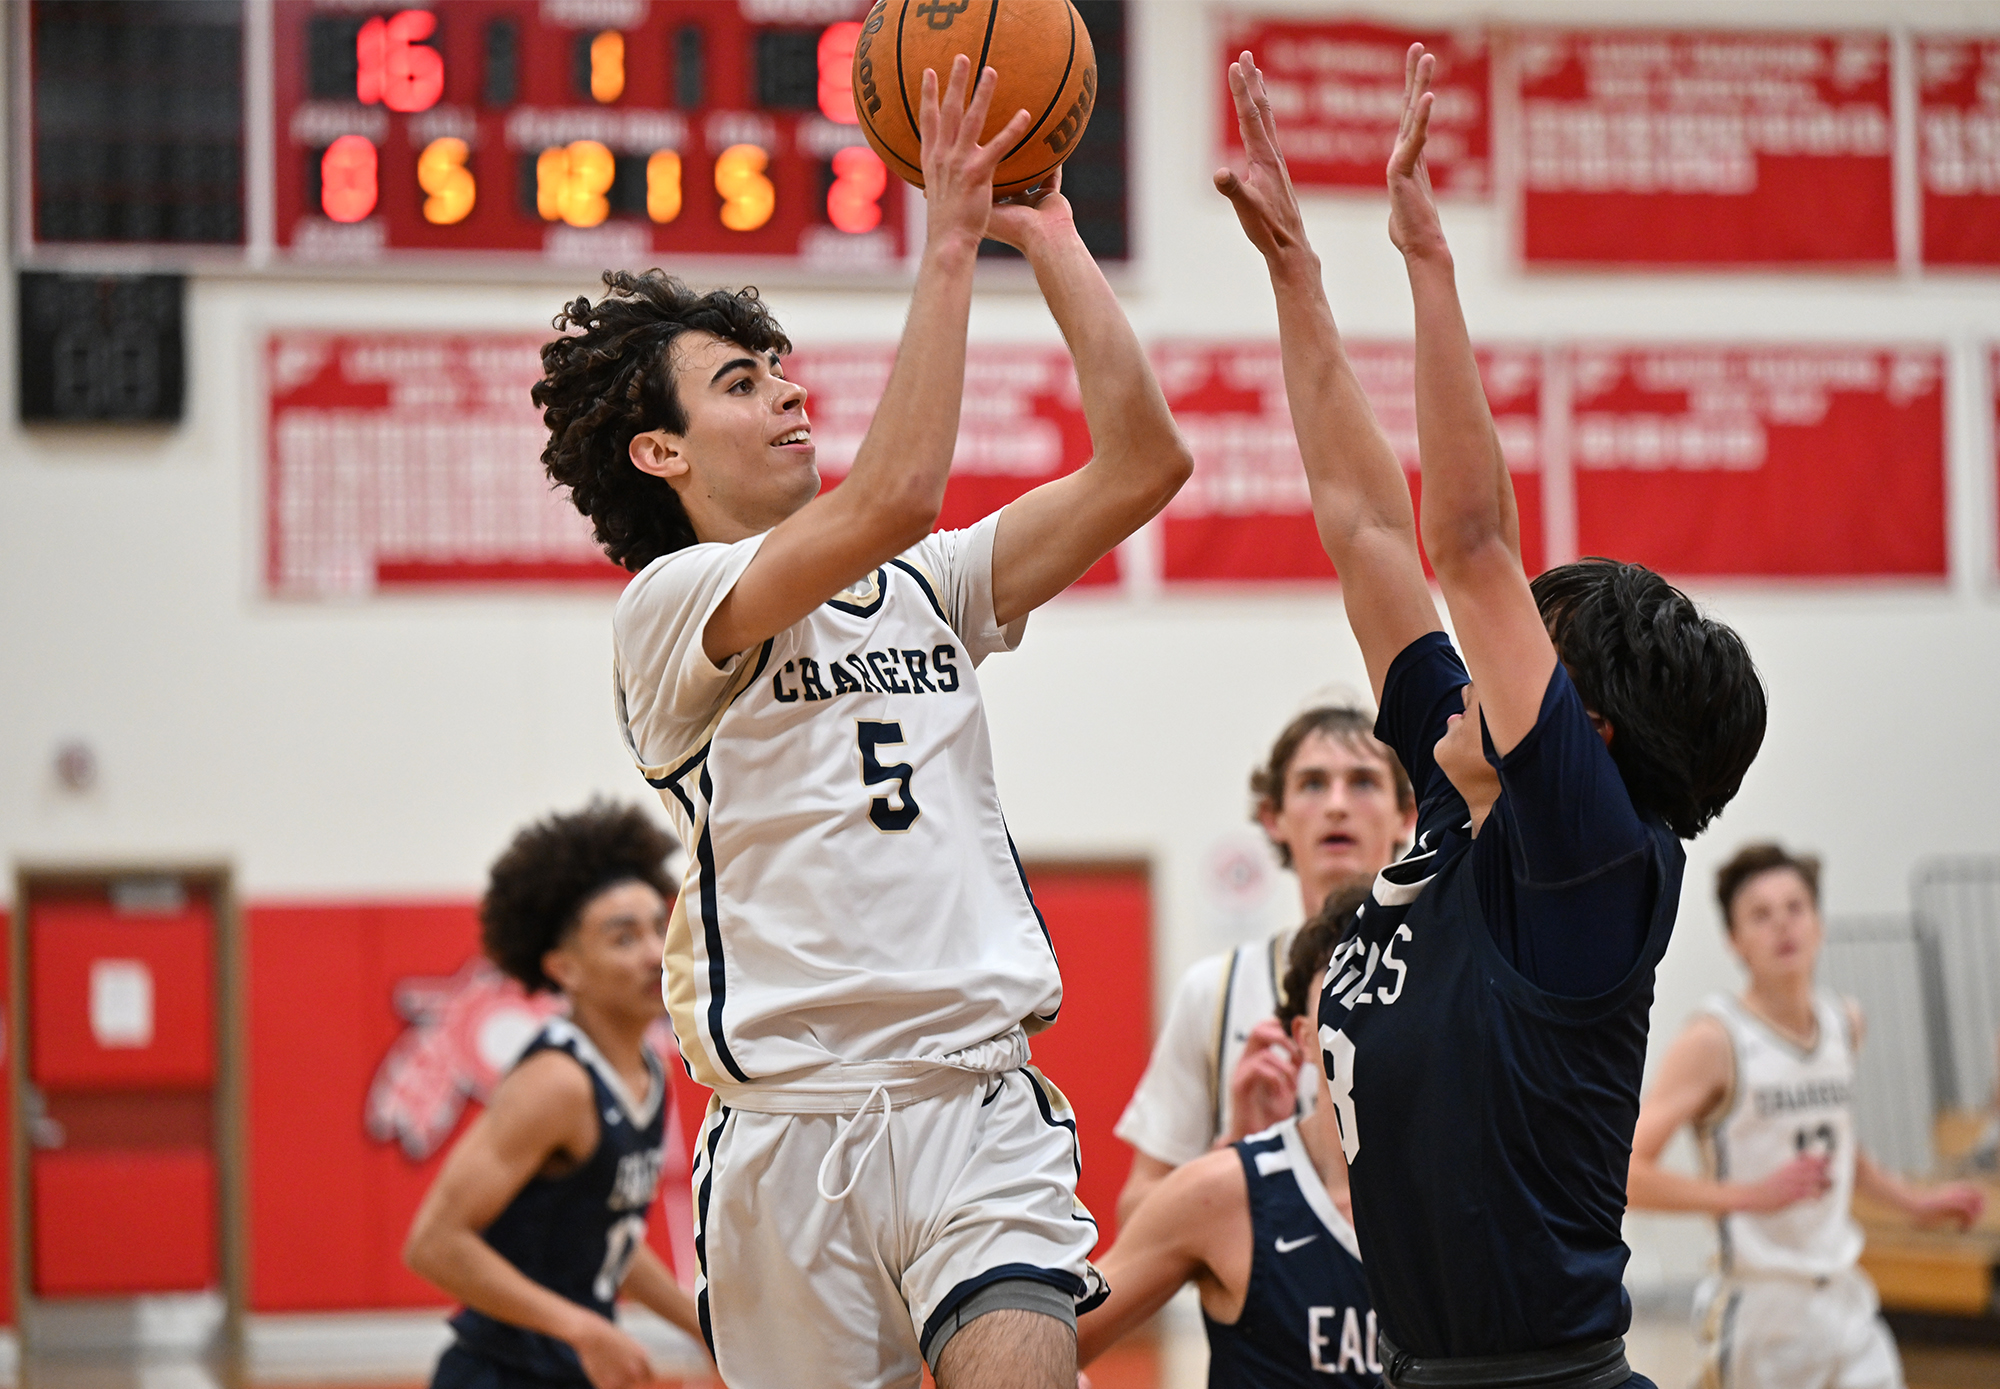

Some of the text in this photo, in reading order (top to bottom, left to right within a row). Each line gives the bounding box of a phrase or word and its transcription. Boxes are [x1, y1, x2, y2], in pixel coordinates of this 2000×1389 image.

[357, 10, 444, 112] 16
[591, 30, 625, 103] 1
[860, 0, 888, 119] ilson
[417, 137, 476, 225] 5
[715, 143, 775, 231] 5
[773, 643, 960, 703] CHARGERS
[853, 717, 922, 834] 5
